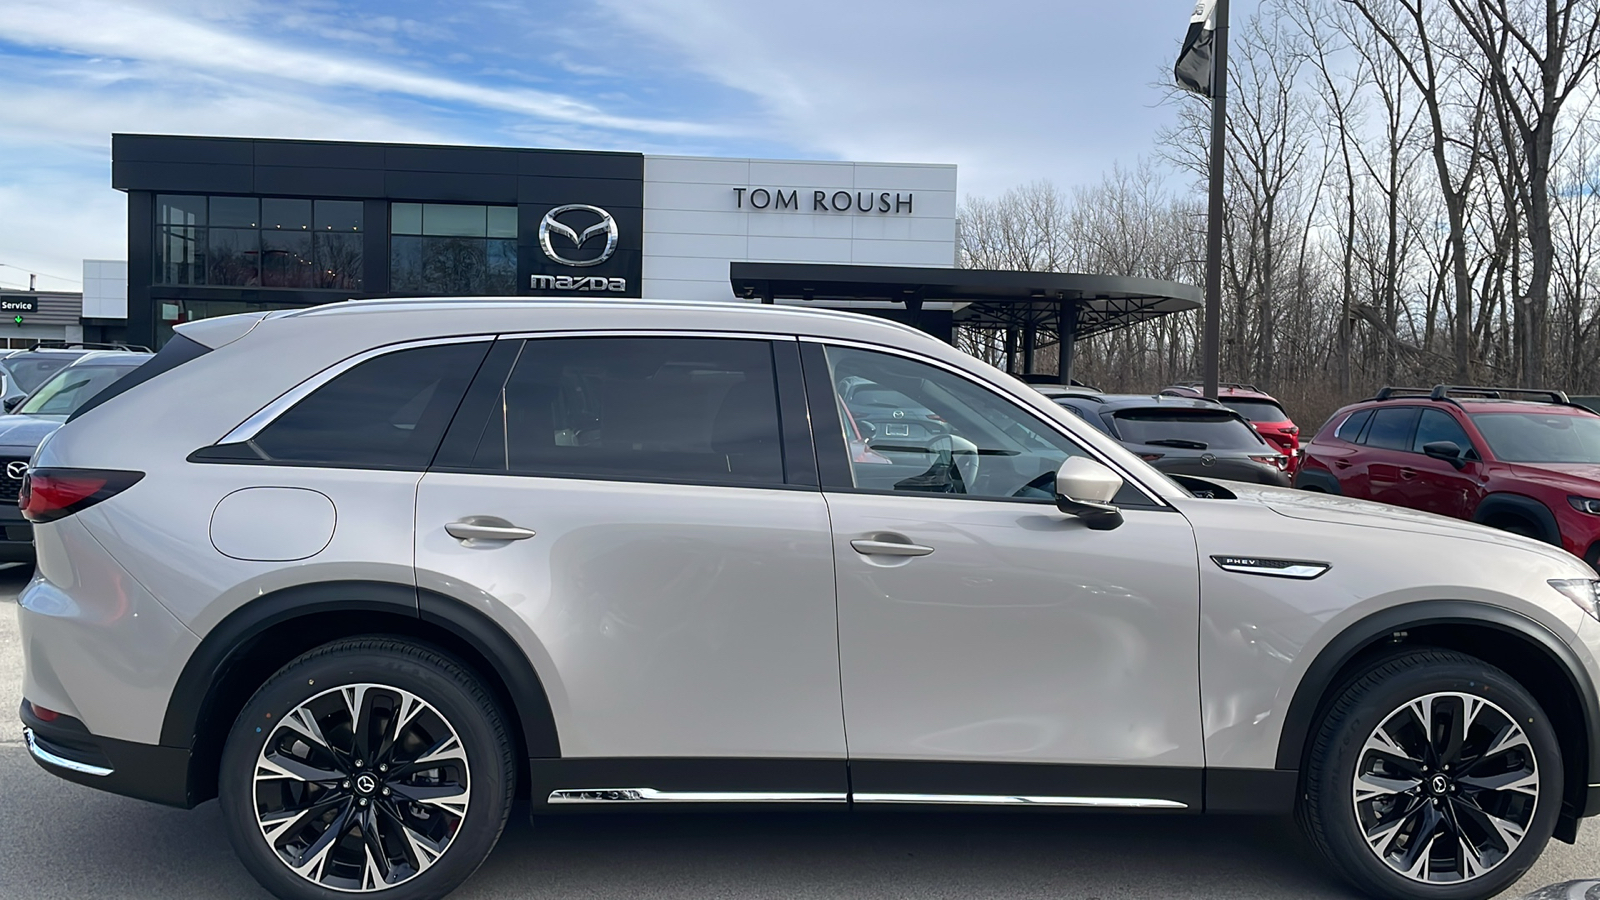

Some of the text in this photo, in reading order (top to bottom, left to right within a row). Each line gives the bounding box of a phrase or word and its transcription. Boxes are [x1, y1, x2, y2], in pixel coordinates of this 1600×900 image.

[733, 187, 912, 214] TOM ROUSH
[1, 301, 32, 310] Service
